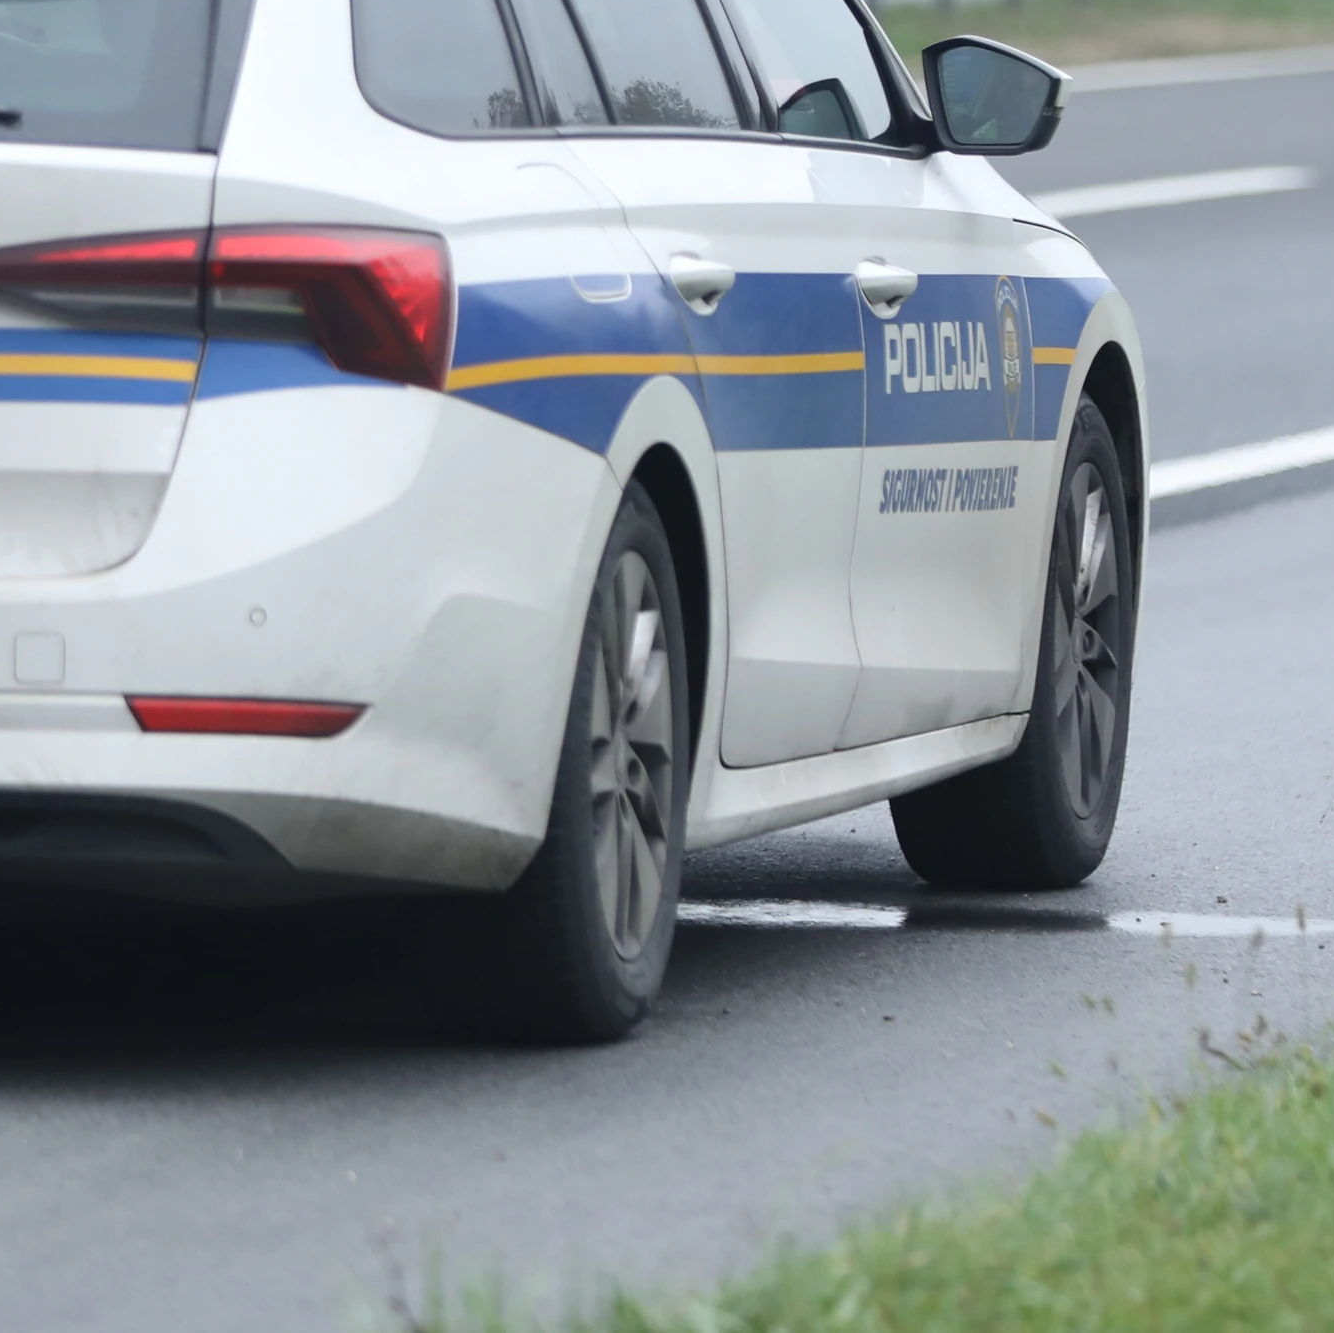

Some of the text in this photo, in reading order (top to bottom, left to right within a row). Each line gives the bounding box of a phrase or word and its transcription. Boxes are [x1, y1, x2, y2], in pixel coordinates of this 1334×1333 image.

[884, 321, 991, 394] POLICIJA
[878, 465, 1019, 515] SIGURNOST I POVJERENJE
